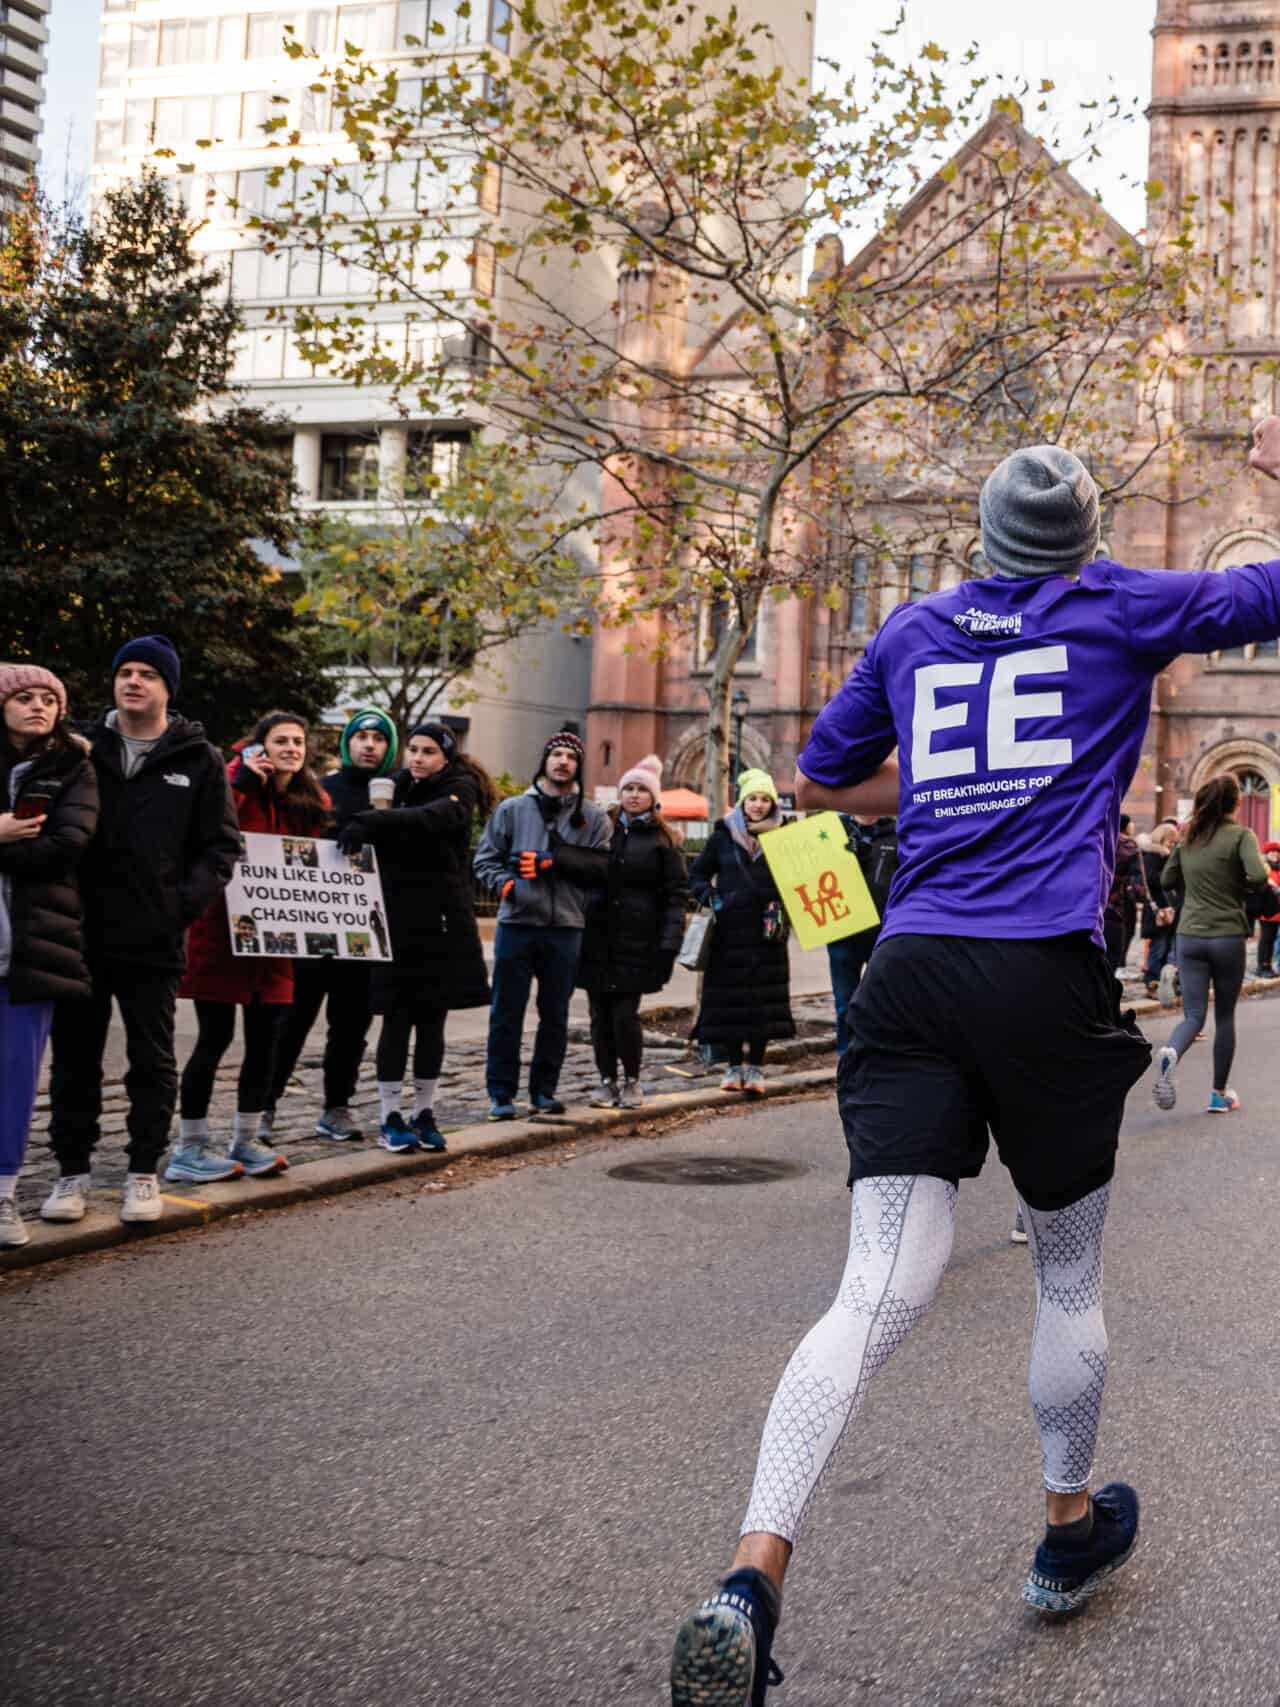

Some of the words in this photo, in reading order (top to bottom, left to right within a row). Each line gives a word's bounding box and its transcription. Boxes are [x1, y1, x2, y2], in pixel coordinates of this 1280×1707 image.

[911, 645, 1073, 784] EE
[913, 791, 932, 804] FAST
[933, 778, 1026, 801] BREAKTHROUGHS
[935, 796, 1034, 818] EMILYSENTOURAGE.OR
[240, 865, 278, 879] RUN
[283, 868, 318, 882] LIKE
[322, 872, 365, 886] LORD
[243, 886, 350, 905] VOLDEMORT
[354, 894, 368, 906] IS
[251, 907, 328, 925] CHASING
[332, 912, 367, 926] YOU
